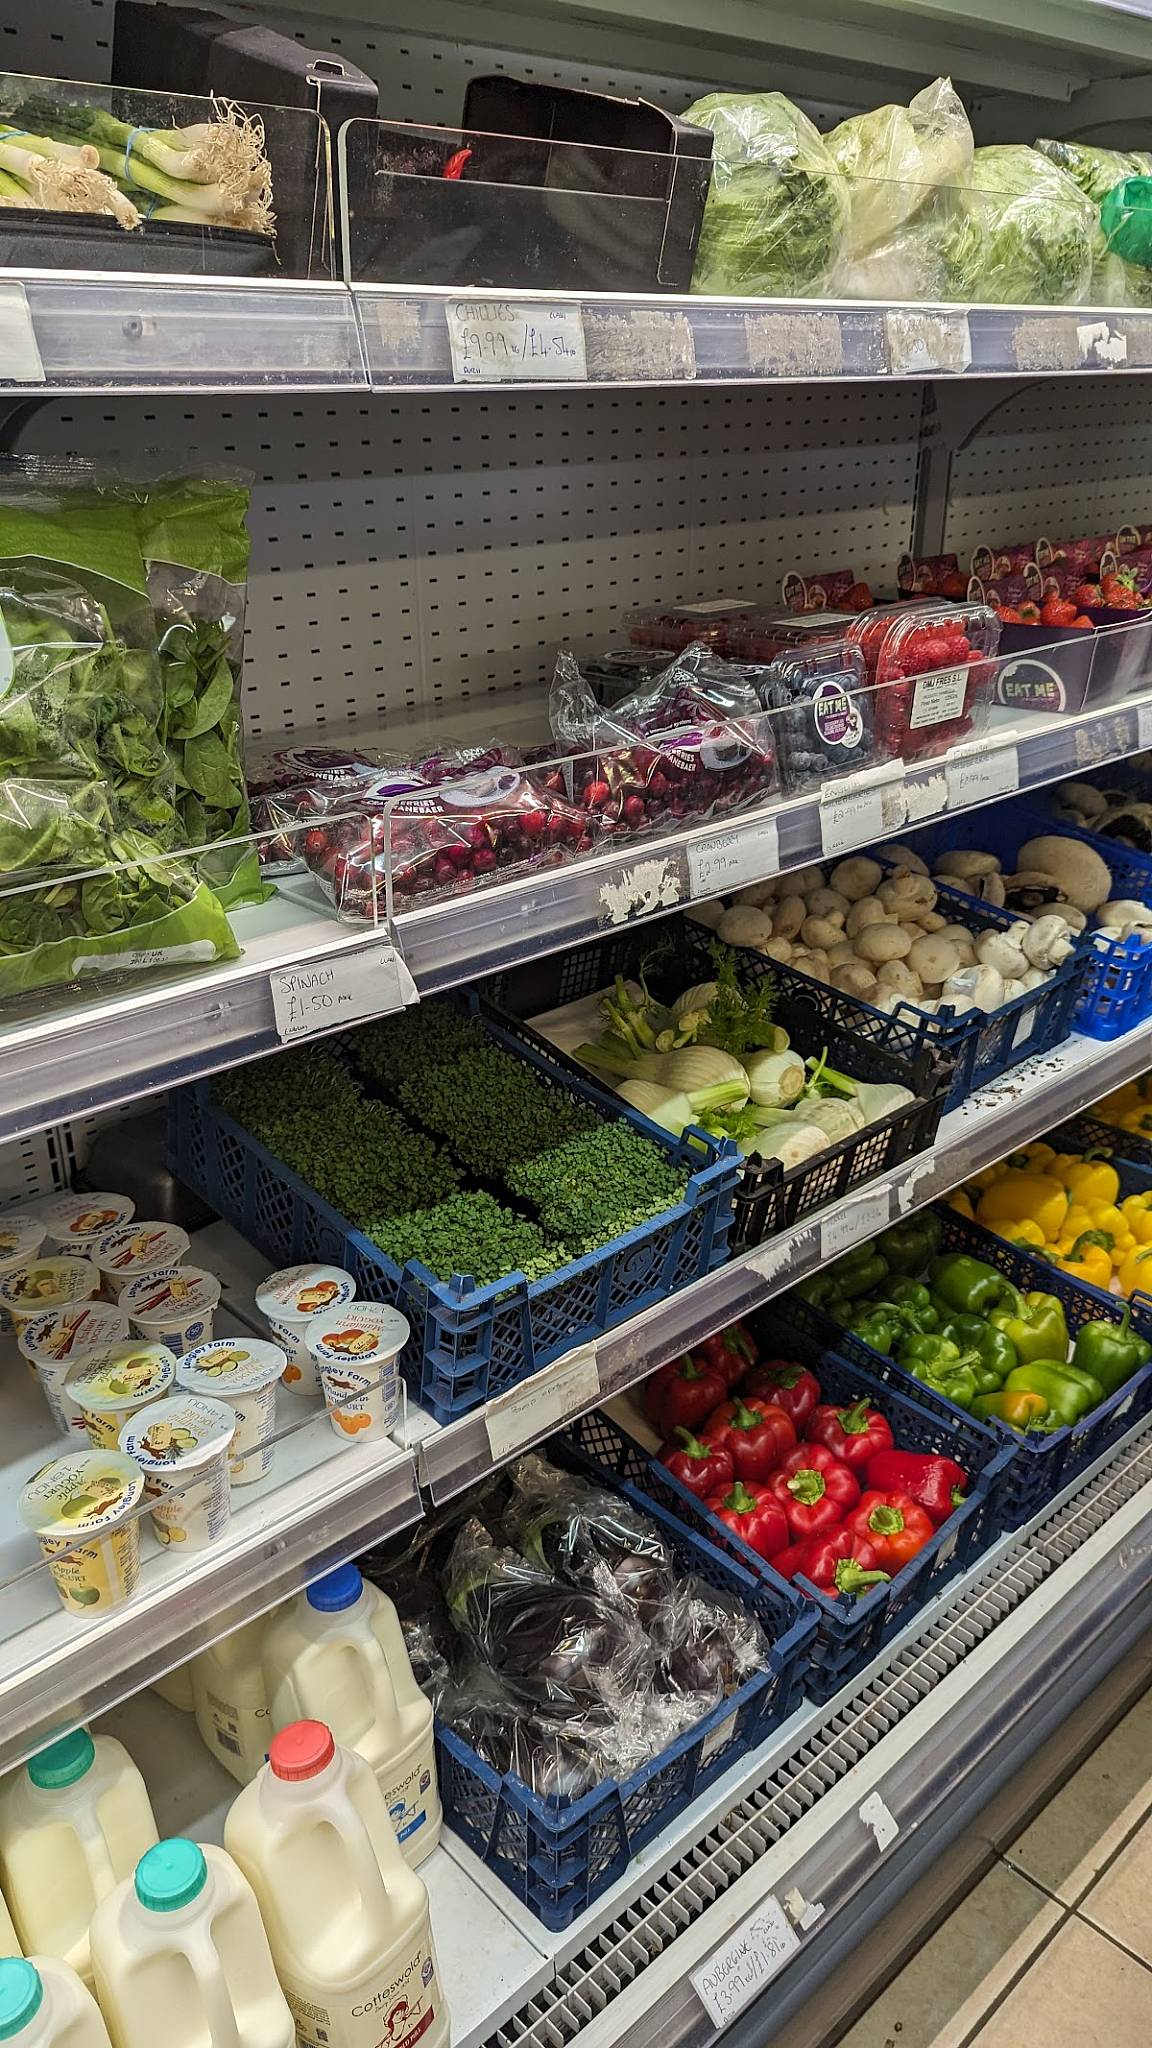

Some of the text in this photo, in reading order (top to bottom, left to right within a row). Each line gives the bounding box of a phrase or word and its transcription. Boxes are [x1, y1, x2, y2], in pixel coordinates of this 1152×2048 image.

[455, 303, 515, 321] CHILLIES
[1005, 682, 1055, 698] EAT ME
[818, 695, 847, 717] EAT ME
[279, 970, 333, 994] SPINACH
[287, 994, 333, 1022] £1.50
[117, 1226, 141, 1235] Farm
[4, 1268, 27, 1282] Farm
[127, 1269, 179, 1298] Longley Farm
[24, 1311, 59, 1351] Longley Farm
[278, 1324, 301, 1343] Farm
[182, 1341, 236, 1369] Longley Farm
[315, 1343, 378, 1362] Longley Farm
[132, 1355, 172, 1398] Longley Farm
[347, 1370, 372, 1387] Farm
[127, 1435, 137, 1455] Farm
[133, 1454, 177, 1467] Longley
[43, 1468, 85, 1501] YOGURT
[57, 1474, 86, 1501] Apple
[77, 1480, 137, 1528] Longley Farm
[54, 1563, 80, 1575] Apple
[384, 1763, 422, 1800] eswold
[702, 1940, 752, 1996] AUBERGINE
[351, 1950, 422, 2018] Cotteswold
